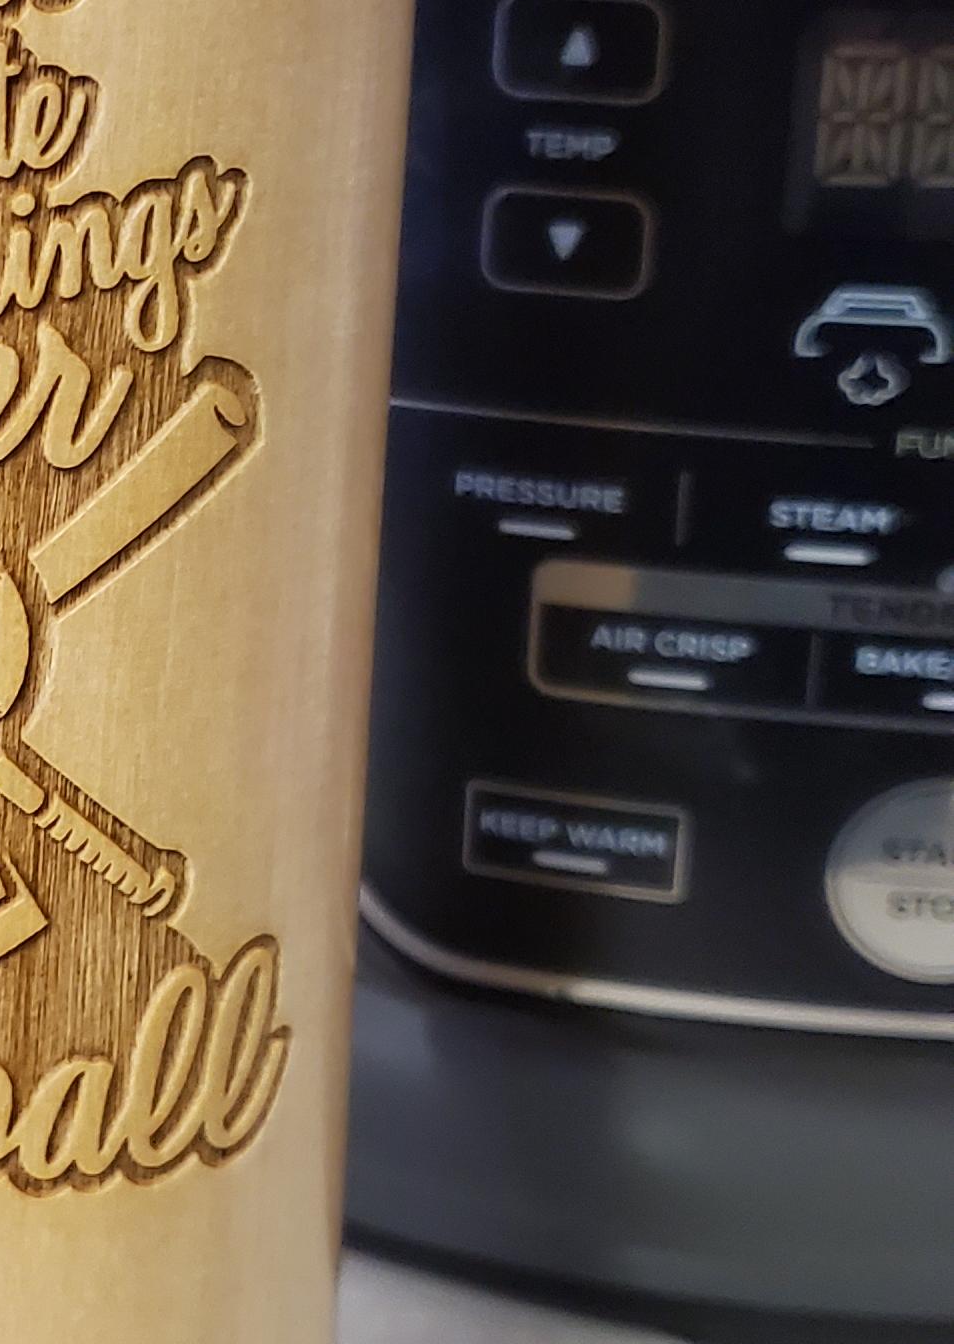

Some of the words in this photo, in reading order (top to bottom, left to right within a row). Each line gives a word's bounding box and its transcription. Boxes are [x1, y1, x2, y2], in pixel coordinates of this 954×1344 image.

[526, 128, 616, 160] TEMP
[454, 469, 625, 515] PRESSURE
[768, 498, 900, 536] STEAM
[591, 623, 648, 654] AIR
[653, 629, 756, 663] CRISP
[854, 646, 954, 680] BAKE
[480, 809, 560, 842] KEEP
[565, 819, 668, 857] WARM
